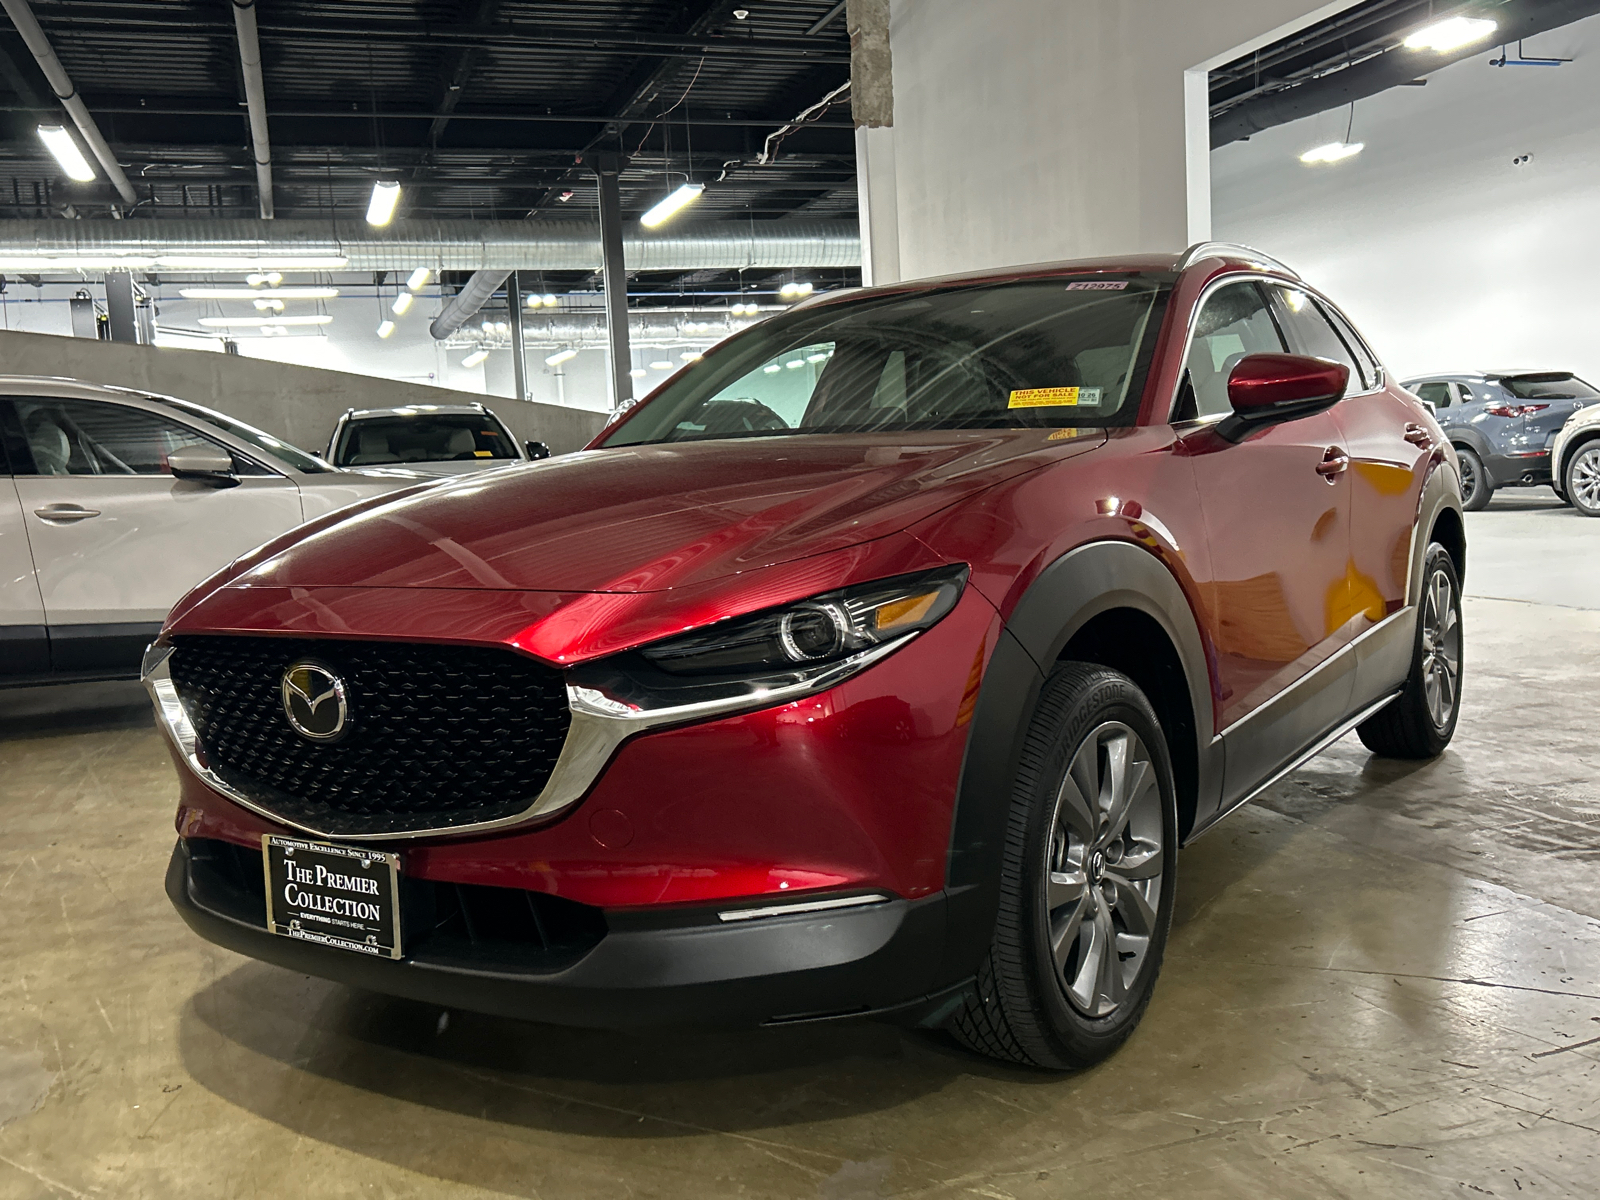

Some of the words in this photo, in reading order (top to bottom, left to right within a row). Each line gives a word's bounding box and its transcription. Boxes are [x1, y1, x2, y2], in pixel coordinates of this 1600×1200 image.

[271, 837, 308, 850] AUTOMOTIVE
[309, 842, 347, 856] EXCELLENCE
[347, 848, 367, 859] SINCE
[368, 852, 386, 862] 1995
[284, 859, 314, 885] THE
[315, 864, 380, 896] PREMIER
[284, 883, 381, 922] COLLECTION
[300, 912, 332, 924] EVERYTHING
[331, 918, 351, 928] STARTS
